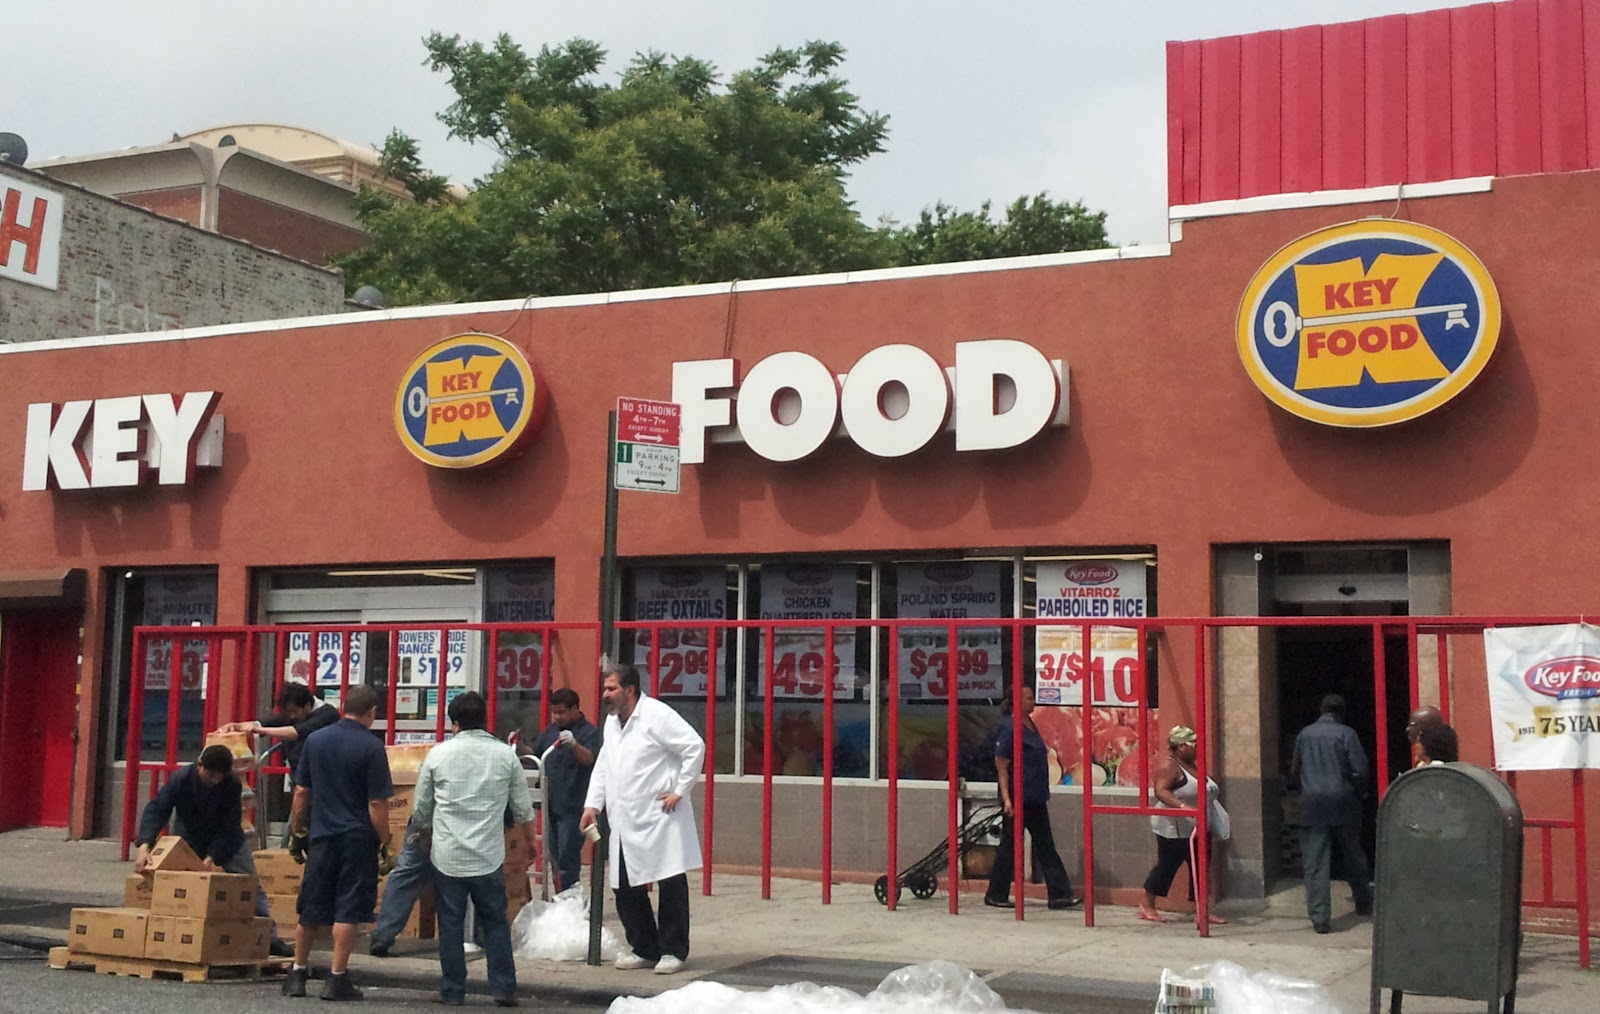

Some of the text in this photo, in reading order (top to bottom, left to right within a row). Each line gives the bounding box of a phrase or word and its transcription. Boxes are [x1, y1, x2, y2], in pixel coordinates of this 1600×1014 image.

[0, 187, 48, 275] H
[1324, 277, 1399, 310] KEY
[1307, 324, 1418, 358] FOOD
[441, 371, 482, 393] KEY
[622, 402, 677, 417] NO STANDING
[672, 339, 1056, 463] FOOD
[431, 401, 491, 424] FOOD
[22, 390, 214, 491] KEY
[622, 444, 627, 462] 1
[636, 452, 675, 463] PARKING
[1069, 567, 1111, 580] Key Food
[901, 592, 995, 606] POLAND SPRING
[1060, 587, 1121, 598] VITARROZ
[163, 602, 212, 614] MINUTE
[638, 598, 724, 619] BEEF OXTAILS
[784, 597, 831, 609] CHICKEN
[1039, 598, 1143, 617] PARBOILED RICE
[929, 608, 968, 618] WATER
[293, 633, 362, 652] CHRRS
[399, 631, 438, 643] ROWERS'
[399, 643, 434, 654] RANGE
[972, 681, 997, 690] PACK
[1534, 665, 1600, 688] Key Foo
[1518, 726, 1536, 736] 1937
[1540, 716, 1566, 734] 75
